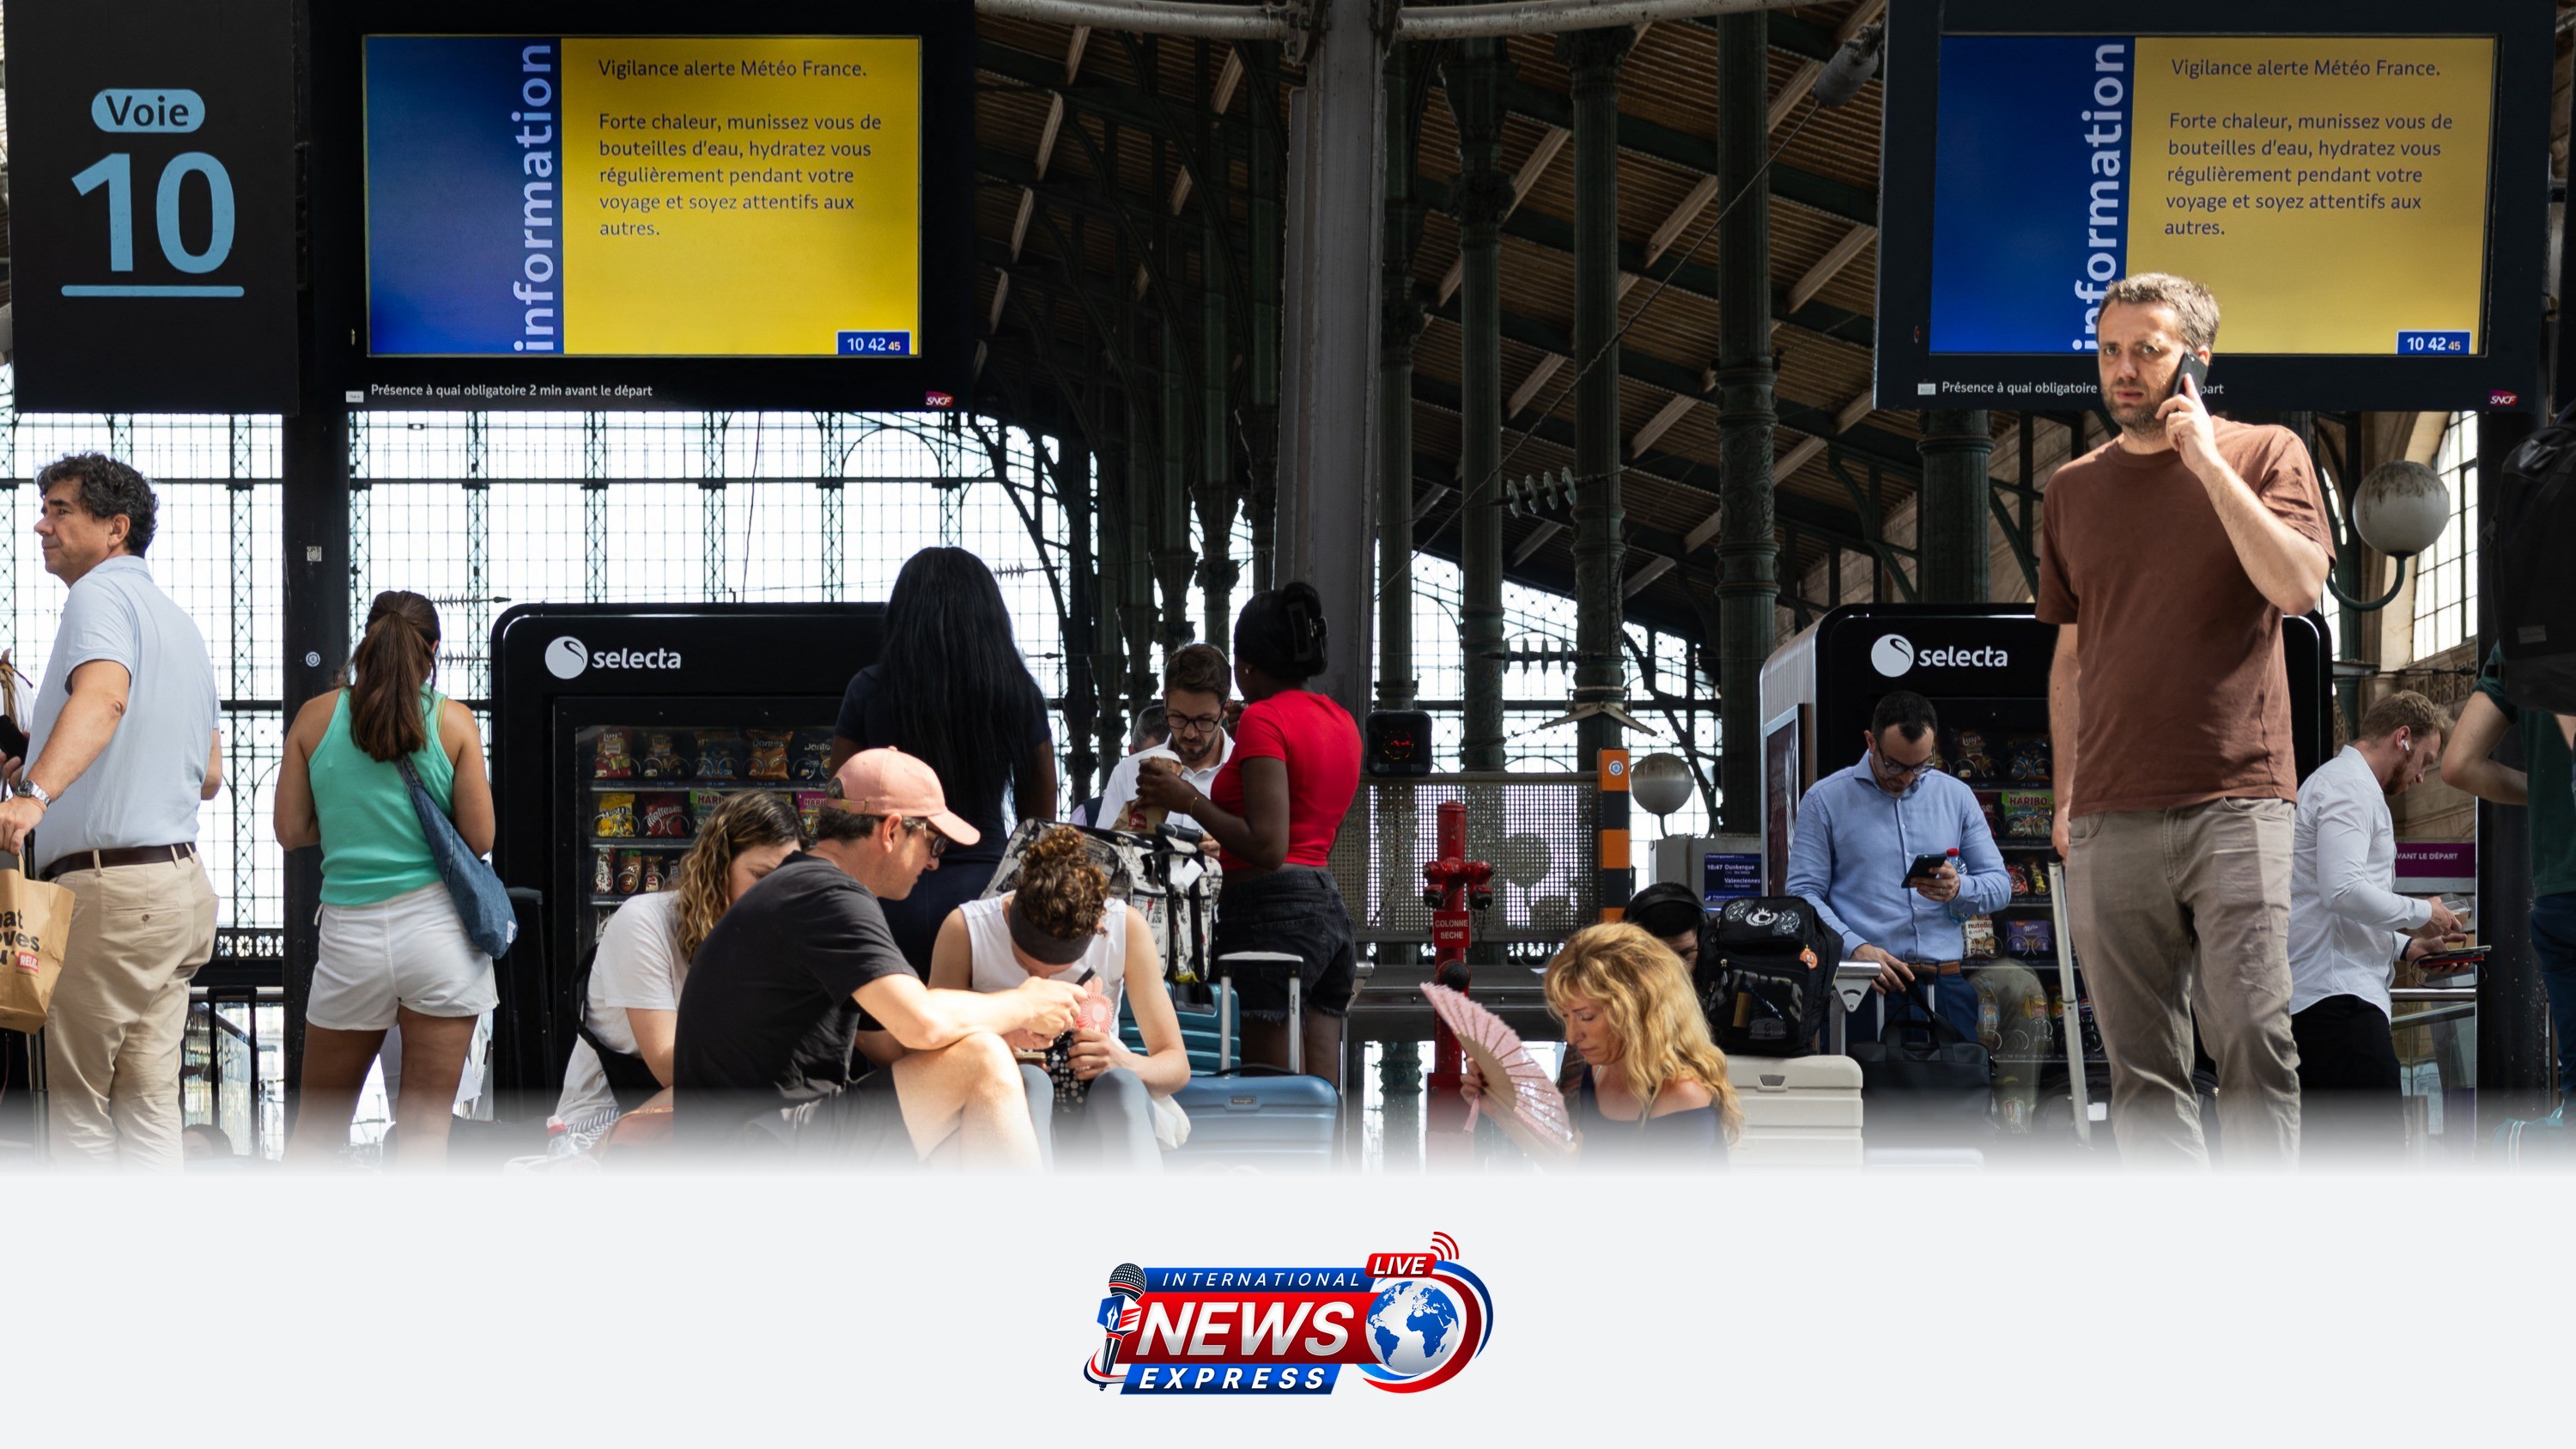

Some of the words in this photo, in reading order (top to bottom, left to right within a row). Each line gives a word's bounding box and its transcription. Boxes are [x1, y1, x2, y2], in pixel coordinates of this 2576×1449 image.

[598, 59, 678, 80] Vigilance
[684, 60, 734, 76] alerte
[741, 59, 797, 76] Météo
[804, 61, 866, 76] France.
[2172, 59, 2251, 79] Vigilance
[2257, 60, 2308, 75] alerte
[2315, 59, 2370, 76] Météo
[2377, 60, 2440, 76] France.
[106, 95, 188, 126] Voie
[600, 113, 646, 129] Forte
[653, 113, 721, 131] chaleur,
[728, 114, 807, 129] munissez
[815, 118, 854, 130] vous
[861, 114, 881, 129] de
[2171, 113, 2216, 128] Forte
[2223, 113, 2292, 131] chaleur,
[2299, 113, 2379, 129] munissez
[2385, 117, 2425, 129] vous
[2432, 113, 2452, 129] de
[600, 140, 686, 156] bouteilles
[693, 140, 744, 158] d'eau,
[750, 141, 825, 159] hydratez
[831, 144, 872, 156] vous
[2169, 140, 2255, 155] bouteilles
[2262, 139, 2312, 158] d'eau,
[2319, 140, 2394, 159] hydratez
[2400, 144, 2441, 155] vous
[600, 167, 723, 186] régulièrement
[730, 167, 802, 186] pendant
[809, 168, 854, 183] votre
[2168, 167, 2291, 186] régulièrement
[2298, 167, 2370, 186] pendant
[2377, 167, 2422, 182] votre
[513, 44, 554, 351] information
[600, 198, 659, 212] voyage
[666, 196, 683, 209] et
[690, 198, 737, 212] soyez
[744, 193, 818, 209] attentifs
[824, 198, 854, 209] aux
[2166, 197, 2227, 212] voyage
[2233, 194, 2250, 208] et
[2256, 197, 2304, 212] soyez
[2310, 193, 2385, 209] attentifs
[2391, 197, 2421, 209] aux
[71, 152, 235, 273] 10
[599, 222, 660, 236] autres.
[2165, 220, 2225, 234] autres.
[848, 338, 865, 351] 10
[868, 338, 886, 351] 42
[889, 341, 901, 351] 45
[2408, 337, 2425, 350] 10
[2427, 337, 2446, 350] 42
[2449, 341, 2461, 350] 45
[371, 384, 422, 396] Présence
[427, 384, 433, 396] à
[436, 384, 460, 399] quai
[465, 384, 526, 399] obligatoire
[530, 384, 537, 396] 2
[540, 384, 562, 396] min
[566, 386, 597, 396] avant
[601, 384, 611, 396] le
[615, 384, 653, 399] départ
[1942, 381, 1994, 393] Présence
[1997, 381, 2004, 393] à
[2008, 381, 2031, 396] quai
[2035, 381, 2097, 396] obligatoire
[2200, 384, 2224, 396] part
[927, 397, 951, 405] SNCF
[2490, 396, 2516, 405] SNCF
[592, 648, 682, 669] selecta
[1918, 645, 2008, 667] selecta
[2009, 796, 2048, 806] HARIBO
[0, 908, 23, 929] at
[1435, 919, 1468, 928] COLONNE
[0, 930, 39, 952] ves
[1440, 931, 1464, 940] SECHE
